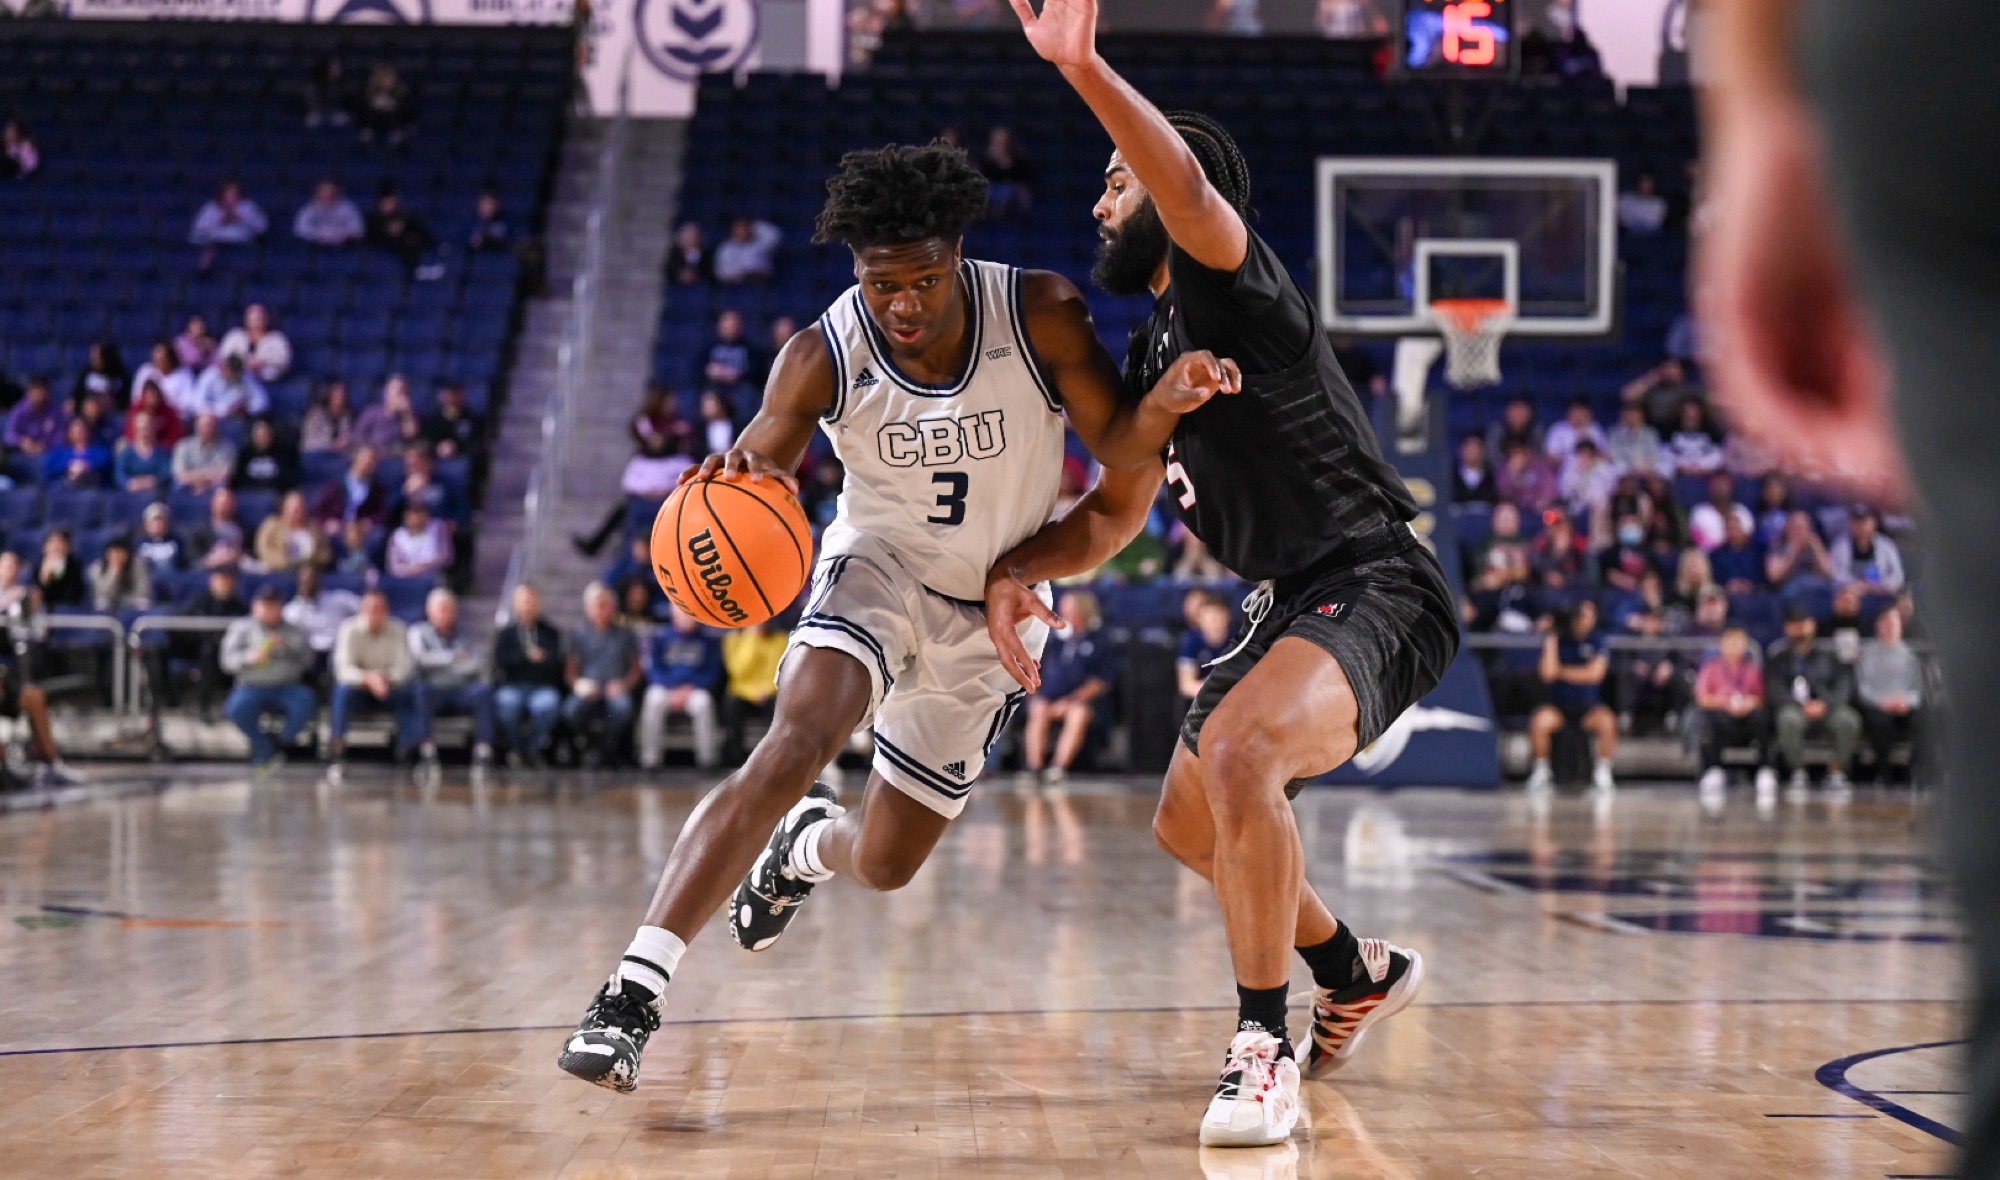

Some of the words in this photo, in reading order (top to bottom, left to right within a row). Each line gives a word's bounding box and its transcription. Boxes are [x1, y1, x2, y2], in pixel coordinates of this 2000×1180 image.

[1442, 1, 1496, 66] 15
[877, 409, 1006, 468] CBU
[927, 471, 969, 525] 3
[688, 527, 749, 623] Wilson
